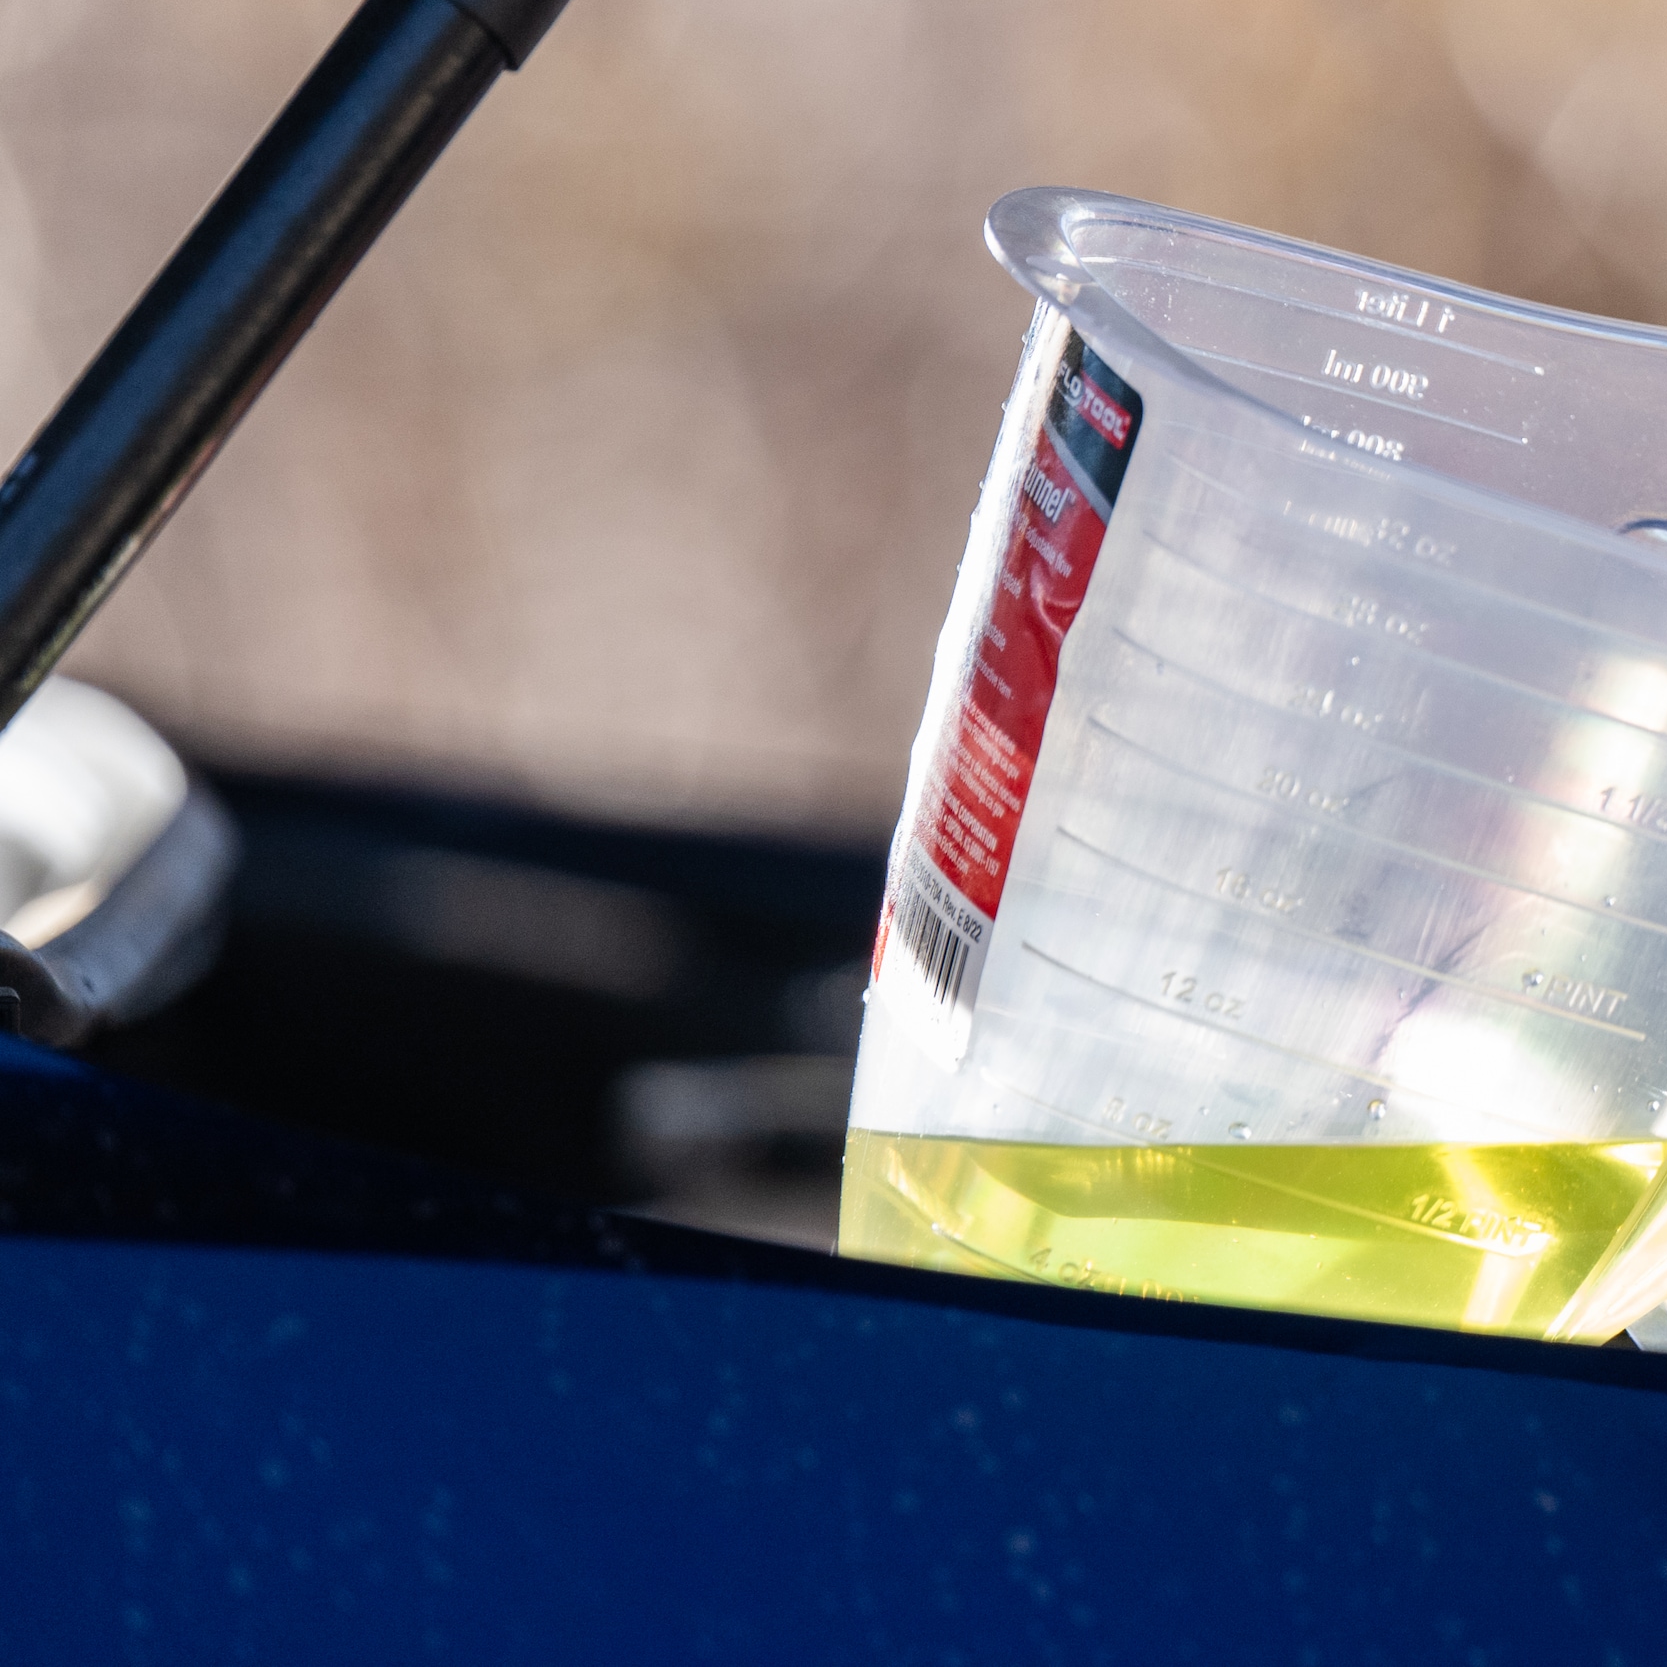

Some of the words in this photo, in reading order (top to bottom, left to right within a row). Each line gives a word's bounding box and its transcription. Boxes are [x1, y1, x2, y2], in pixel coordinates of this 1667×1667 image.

[1161, 970, 1197, 1003] 12
[1204, 992, 1246, 1019] oz
[1411, 1194, 1458, 1228] 1/2
